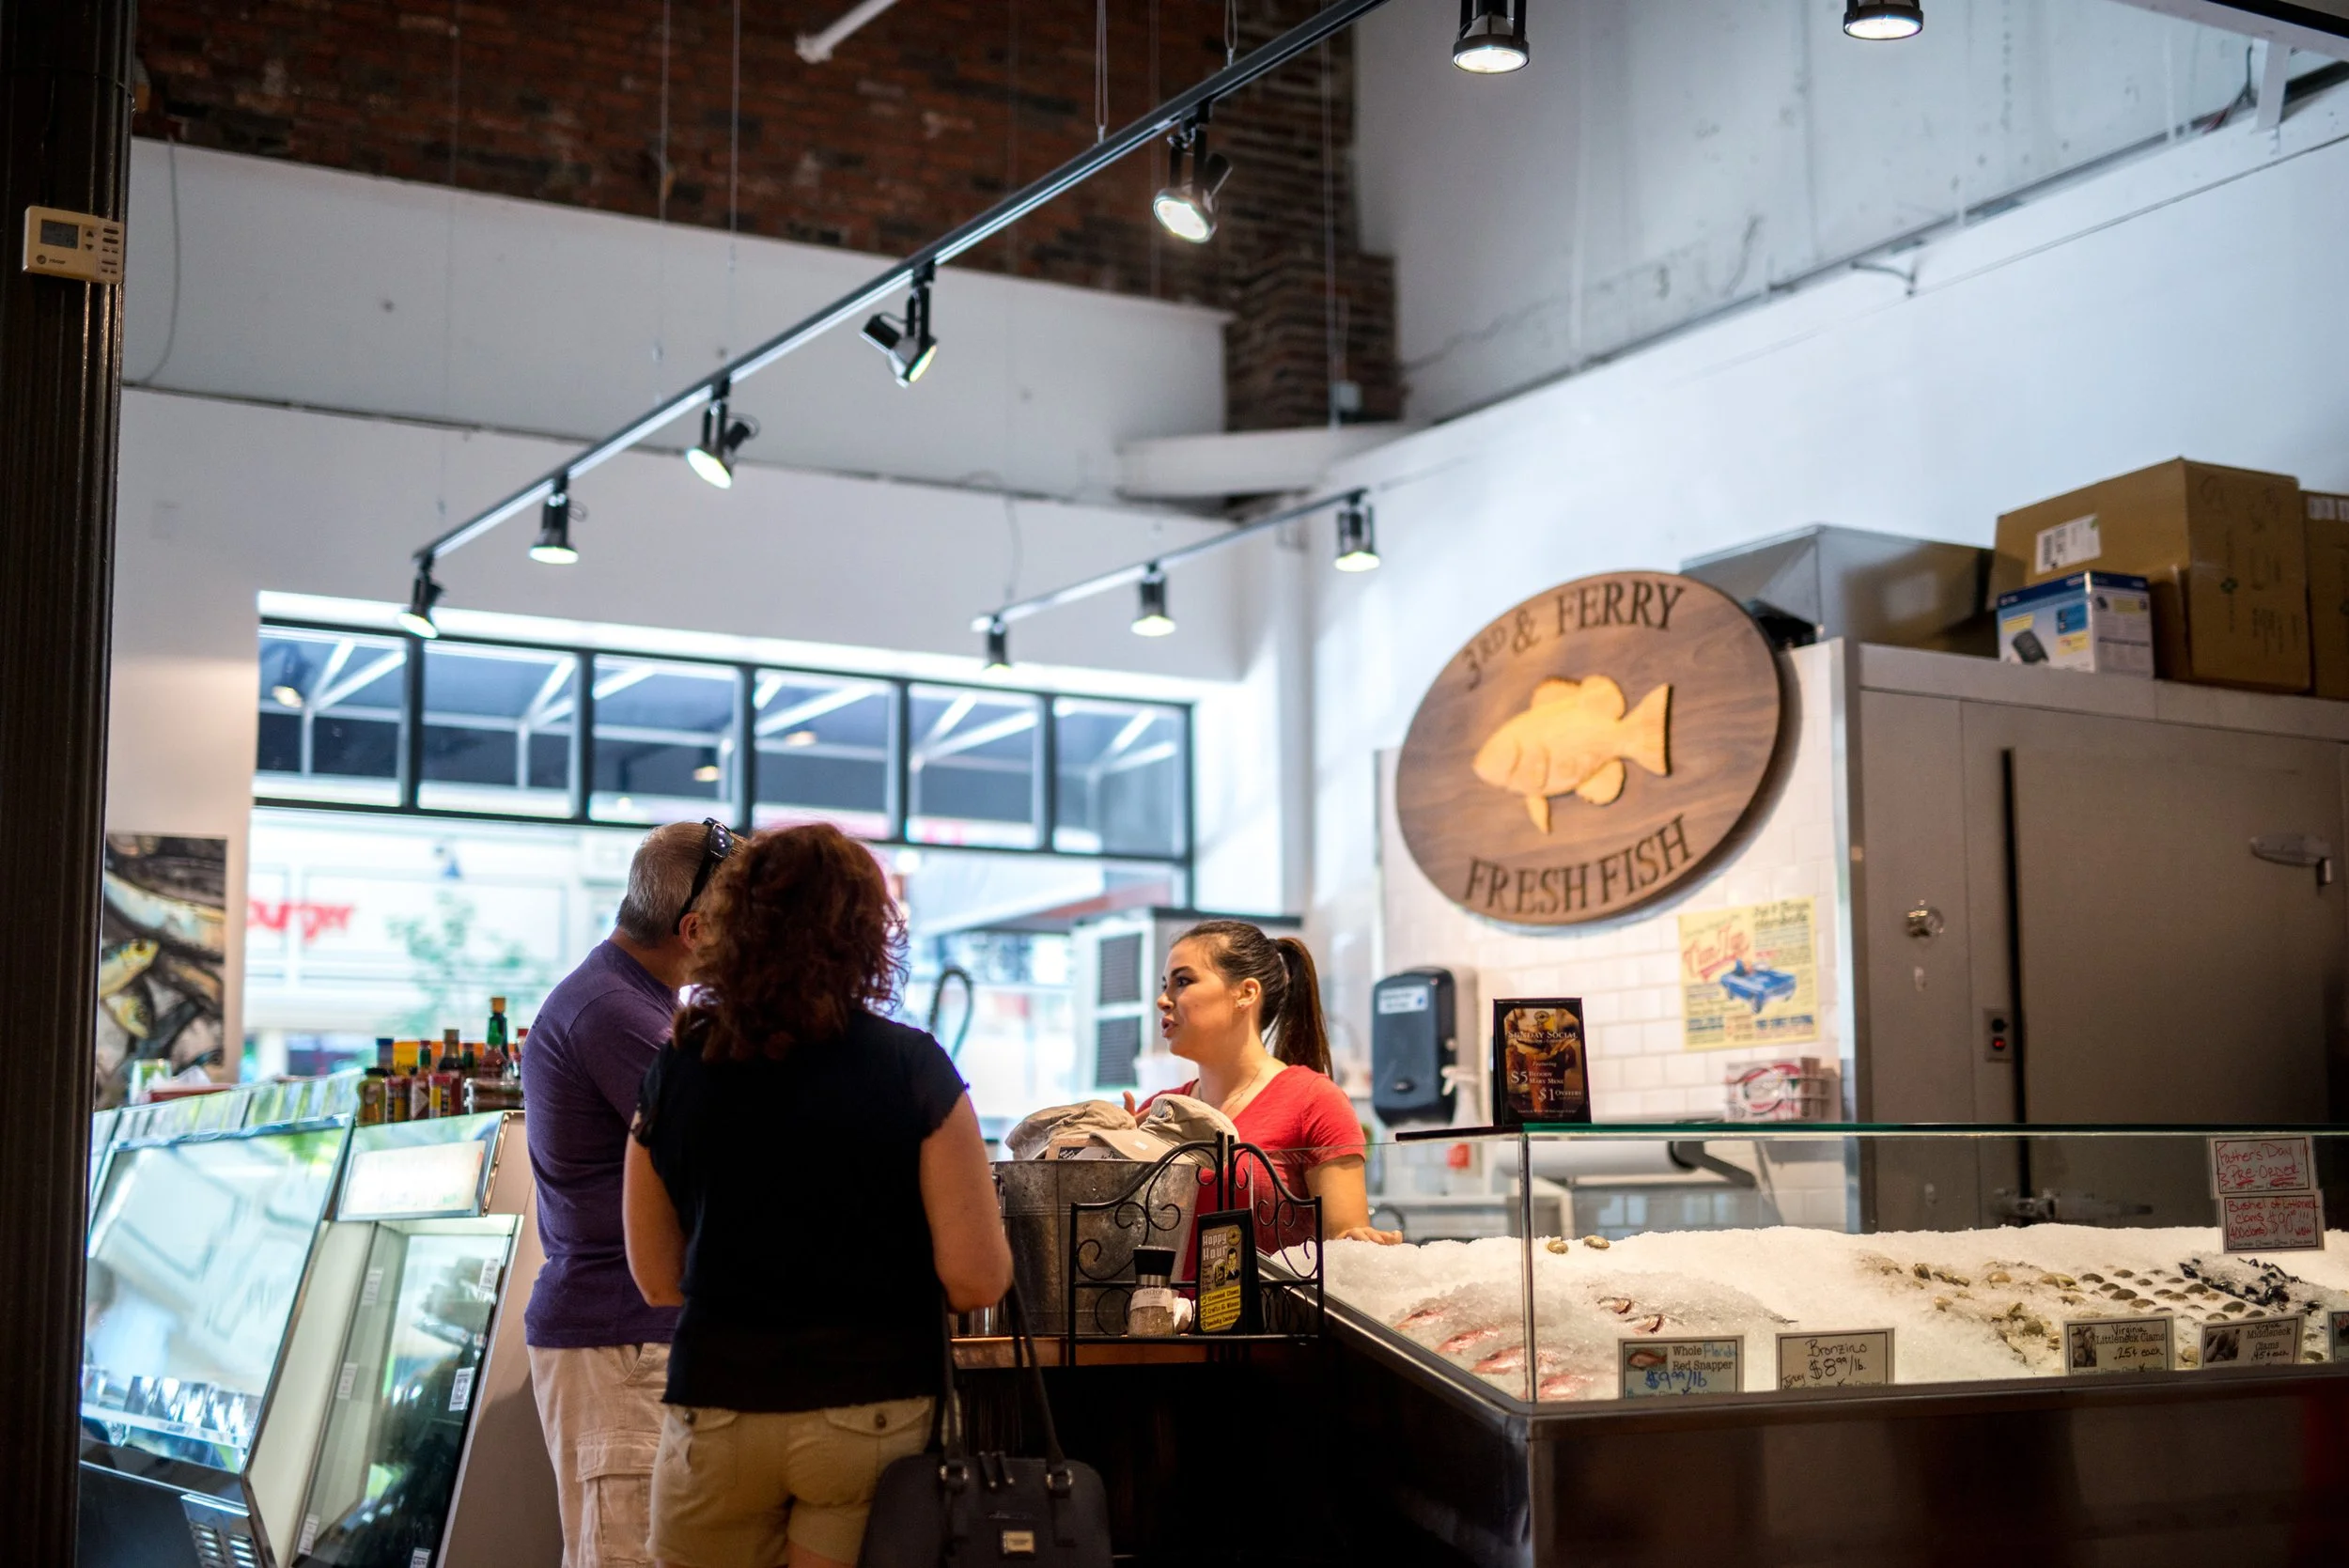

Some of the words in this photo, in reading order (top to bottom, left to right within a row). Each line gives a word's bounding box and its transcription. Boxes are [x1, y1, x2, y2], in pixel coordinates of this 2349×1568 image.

[1511, 607, 1542, 657] &
[1555, 580, 1687, 639] FERRY
[1463, 855, 1592, 916] FRESH
[1595, 813, 1695, 907] FISH
[1511, 1070, 1528, 1084] $5
[2217, 1142, 2263, 1166] Father's
[2228, 1200, 2265, 1212] Bushel
[1203, 1246, 1228, 1261] Hour
[2111, 1324, 2147, 1335] Virginia
[2247, 1327, 2291, 1339] Middleneck
[2096, 1333, 2139, 1344] Littleneck
[2140, 1333, 2165, 1343] Clams
[1672, 1345, 1702, 1356] Whole
[1805, 1339, 1867, 1357] Bronzino
[2141, 1347, 2164, 1357] each
[2255, 1342, 2279, 1351] Clams
[1672, 1361, 1690, 1371] Red
[1693, 1360, 1734, 1372] Snapper
